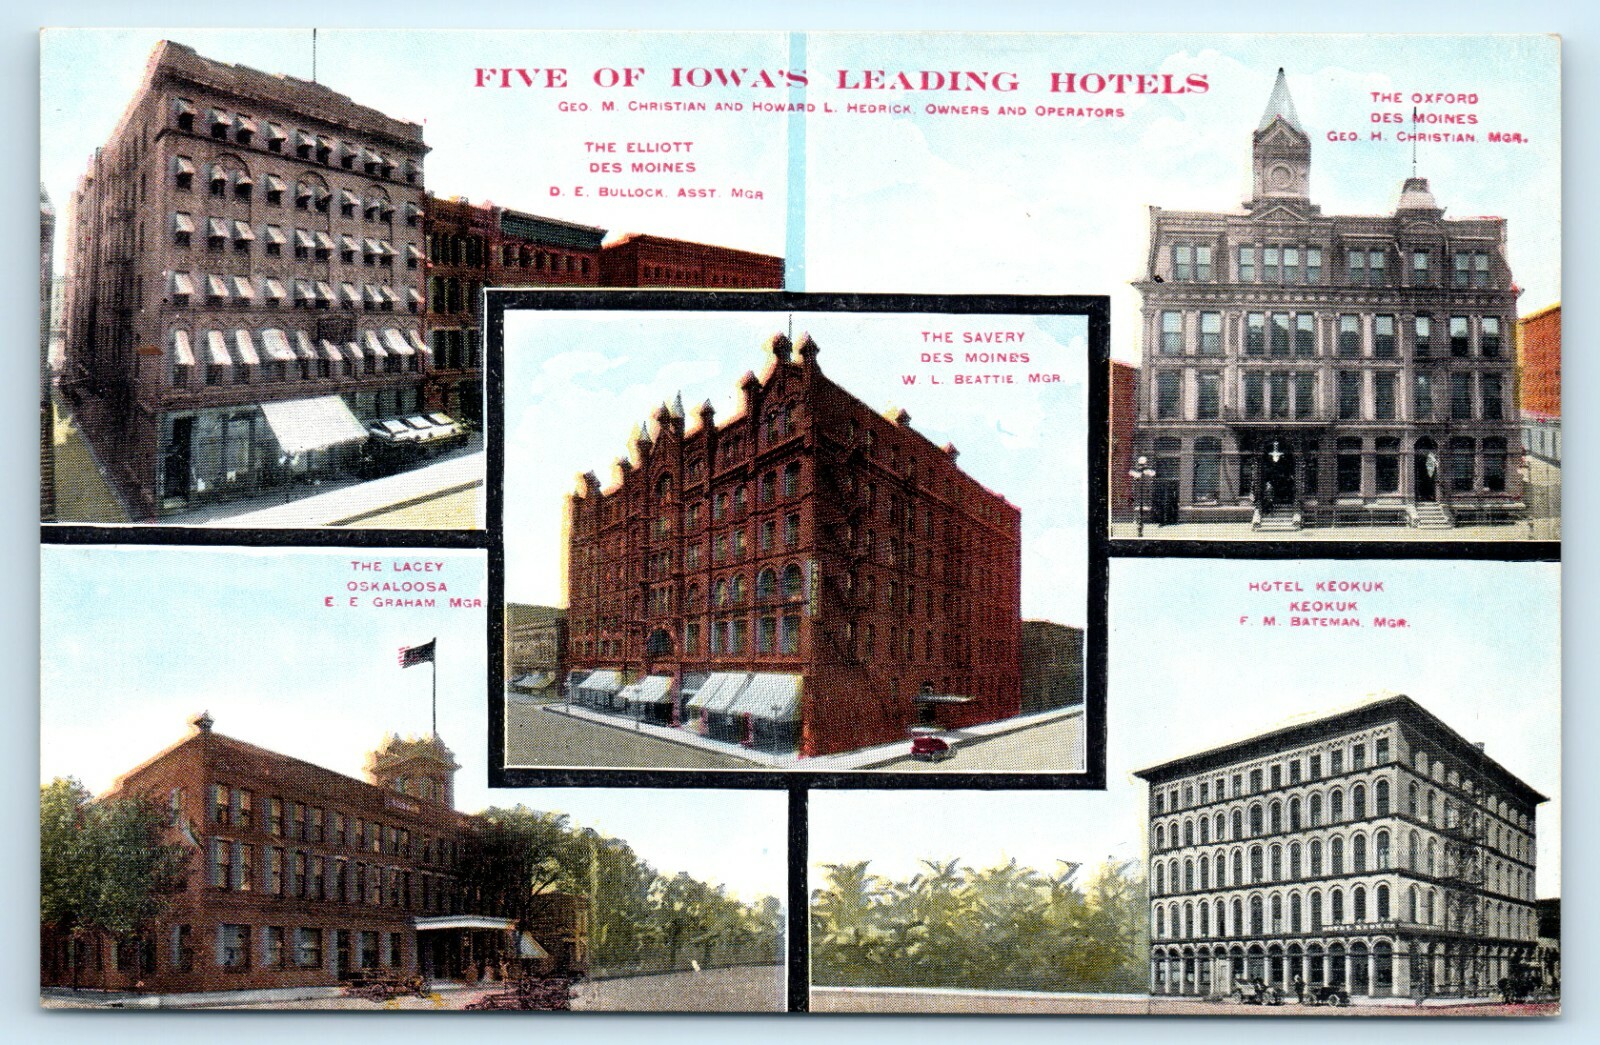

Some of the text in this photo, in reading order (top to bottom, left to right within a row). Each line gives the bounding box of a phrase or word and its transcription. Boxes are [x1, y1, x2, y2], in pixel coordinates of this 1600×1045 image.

[475, 67, 1209, 95] FIVE OF IOWA'S LEADING HOTELS
[1370, 91, 1478, 105] THE OXFORD
[628, 101, 706, 111] CHRISTIAN
[715, 102, 743, 111] AND
[753, 103, 816, 113] HOWARD
[926, 104, 989, 115] OWNERS
[998, 106, 1027, 116] AND
[1035, 105, 1124, 118] OPERATORS
[1370, 112, 1478, 125] DES MOINES
[584, 141, 693, 153] THE ELLIOTT
[589, 162, 696, 173] DES MOINES
[921, 331, 1024, 343] THE SAVERY
[921, 352, 1030, 363] DES MOINES
[351, 561, 444, 572] THE LACEY
[347, 581, 447, 592] OSKALOOSA
[1249, 581, 1382, 592] HOTEL KEOKUK
[1291, 601, 1356, 612] KEOKUK
